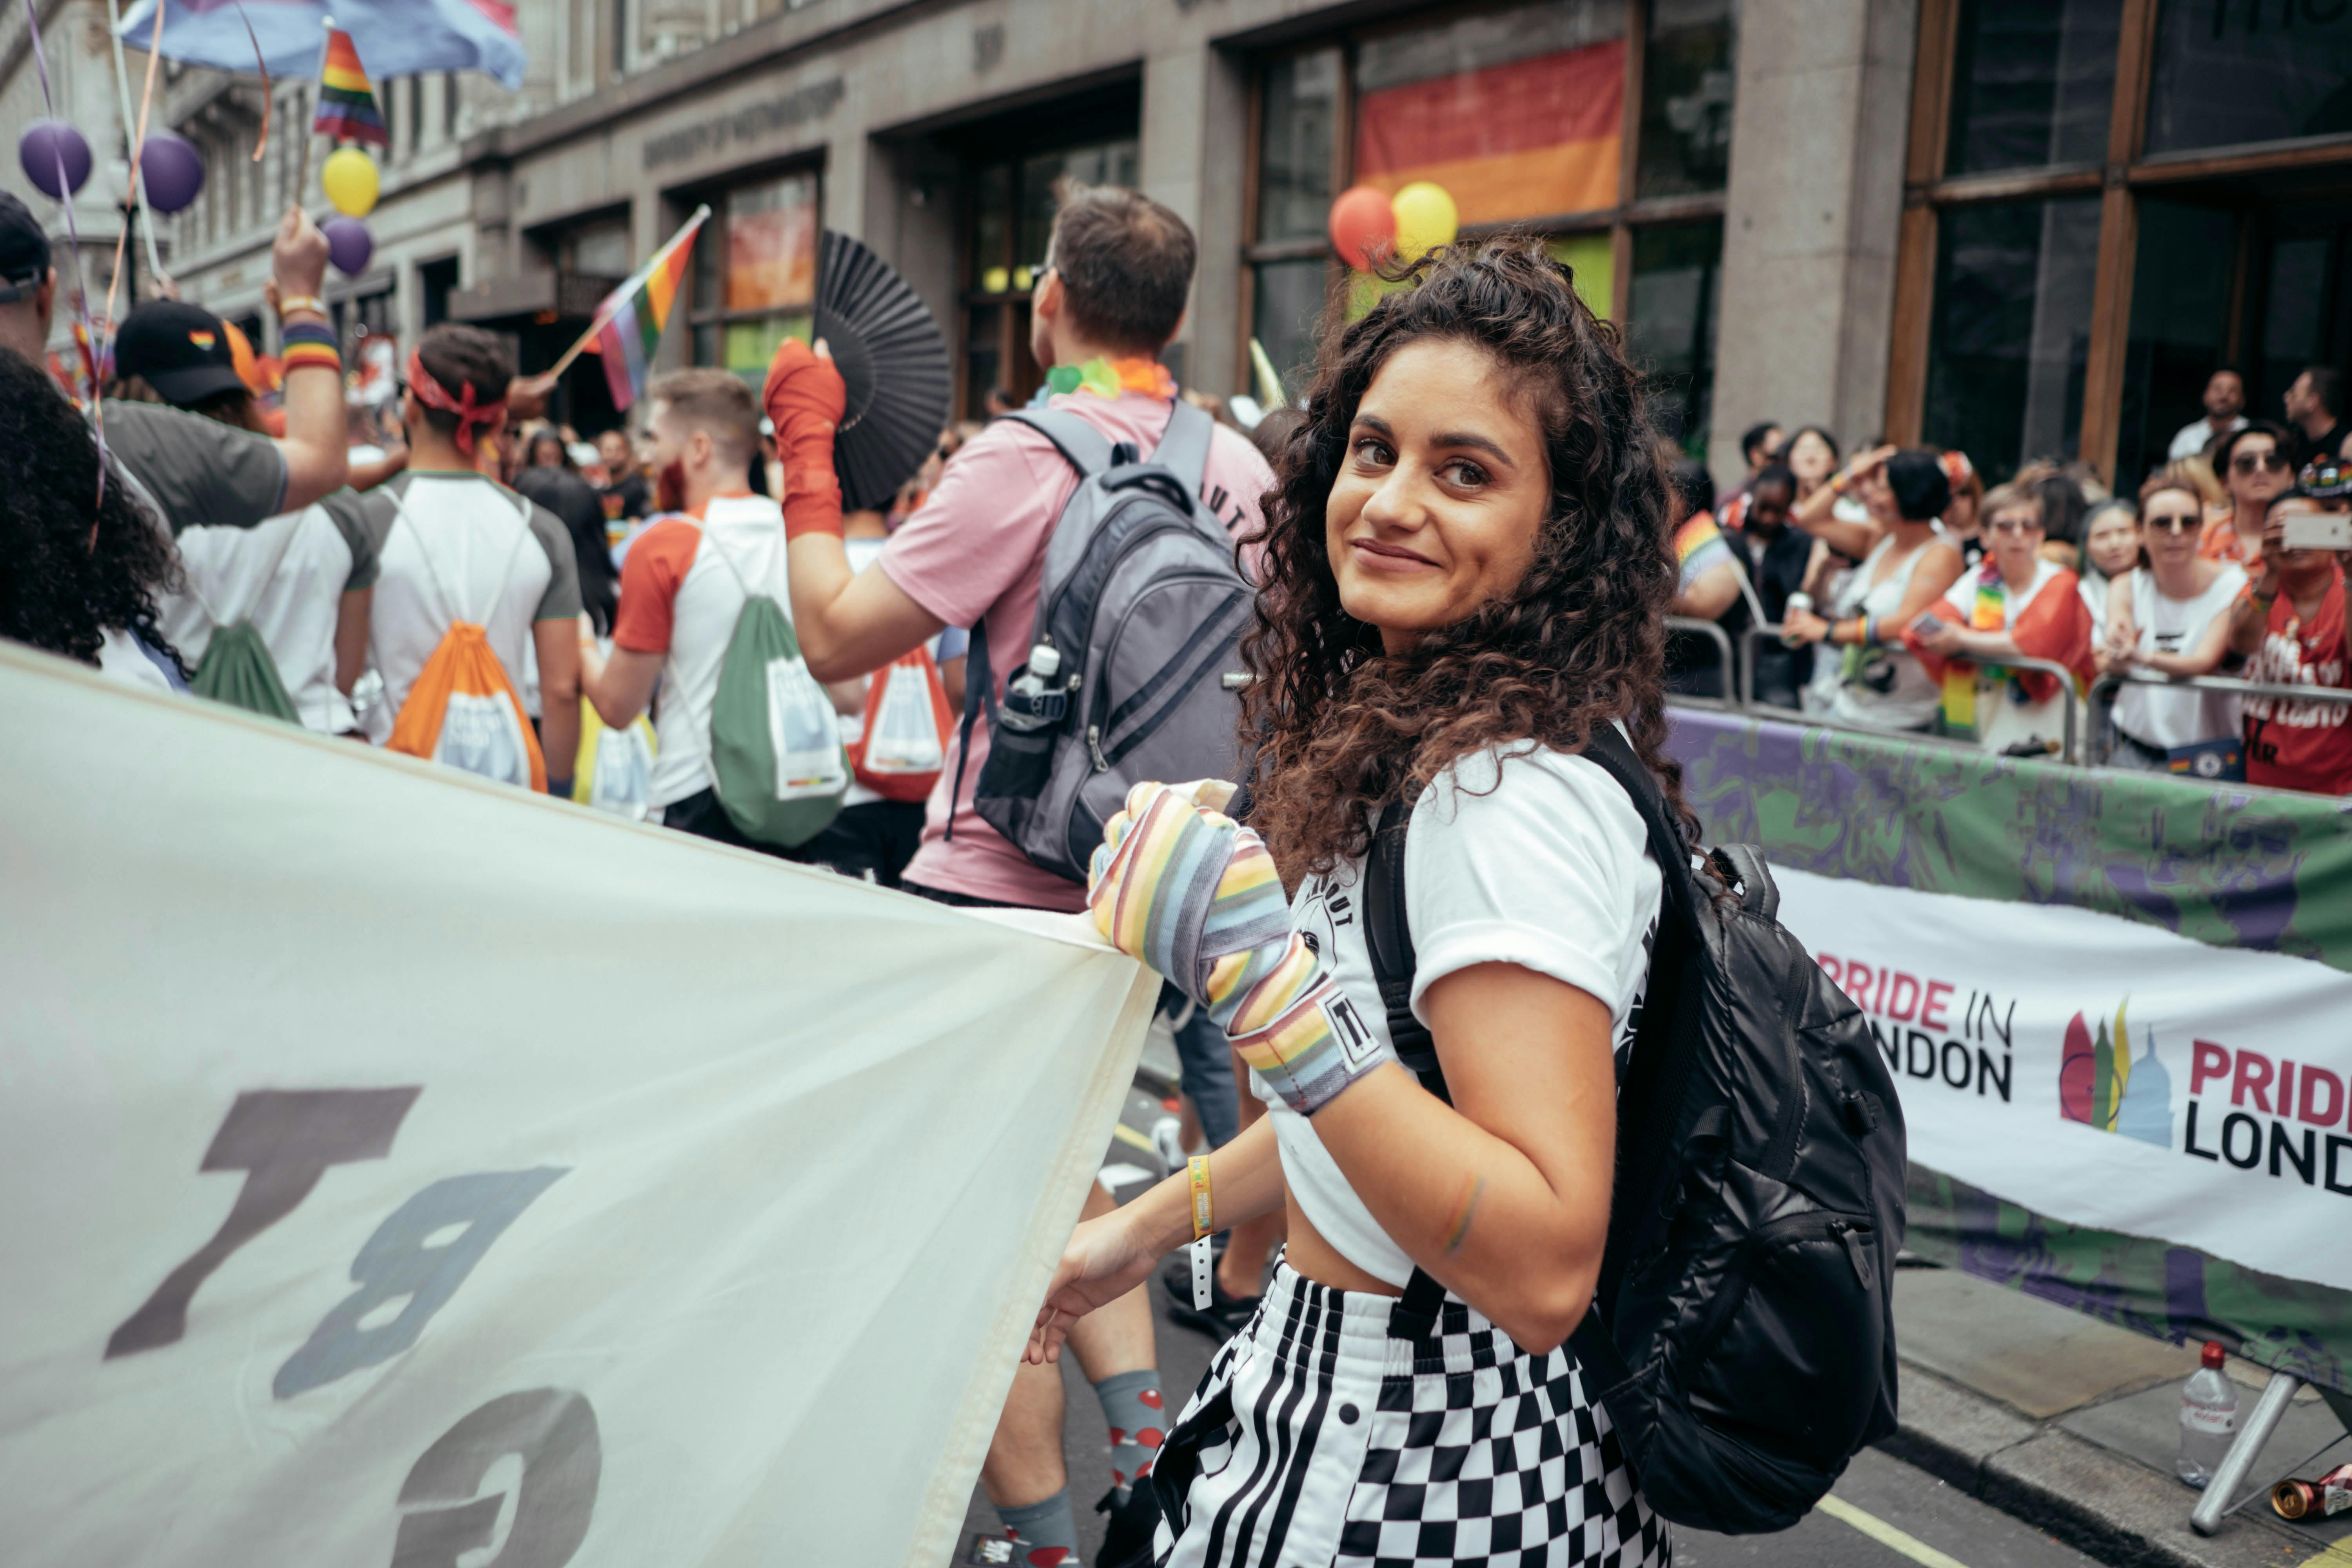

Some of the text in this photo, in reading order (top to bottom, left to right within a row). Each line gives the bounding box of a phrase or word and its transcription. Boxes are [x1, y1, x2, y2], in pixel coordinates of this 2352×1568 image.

[1199, 482, 1245, 531] UT
[1817, 953, 2015, 1048] PRIDE IN
[1871, 1020, 2012, 1103] NDON
[2190, 1038, 2352, 1134] PRID
[2185, 1100, 2352, 1196] LOND
